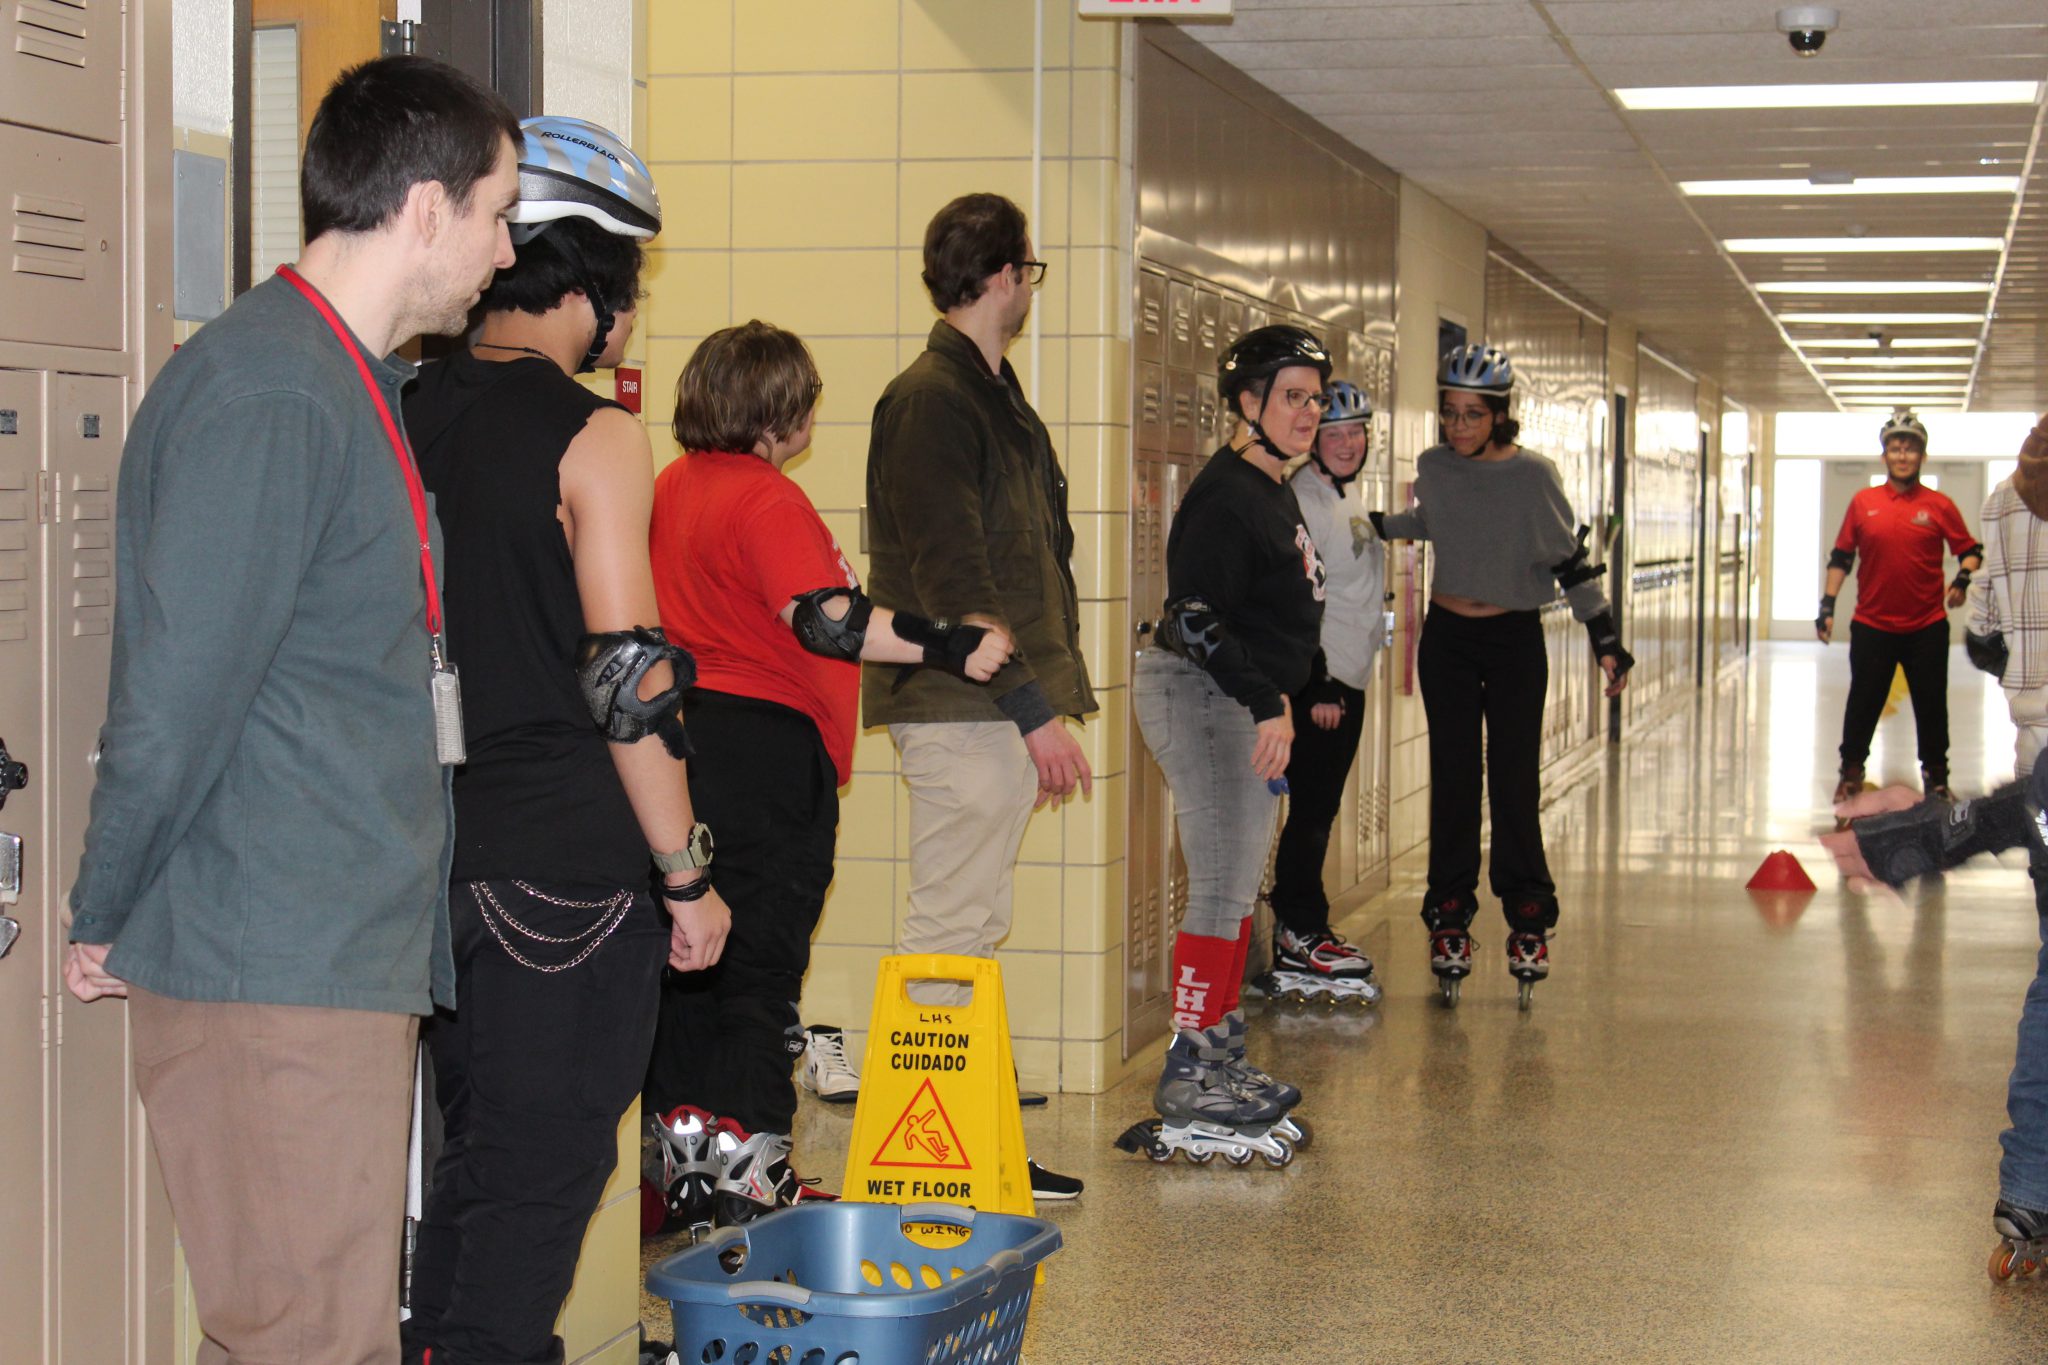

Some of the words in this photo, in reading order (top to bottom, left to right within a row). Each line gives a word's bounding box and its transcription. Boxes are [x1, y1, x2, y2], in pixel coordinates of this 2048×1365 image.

[622, 380, 638, 394] STAIR
[919, 1012, 952, 1024] LHS
[890, 1031, 969, 1048] CAUTION
[891, 1053, 966, 1071] CUIDADO
[867, 1180, 905, 1196] WET
[912, 1181, 971, 1198] FLOOR
[921, 1226, 969, 1237] WING
